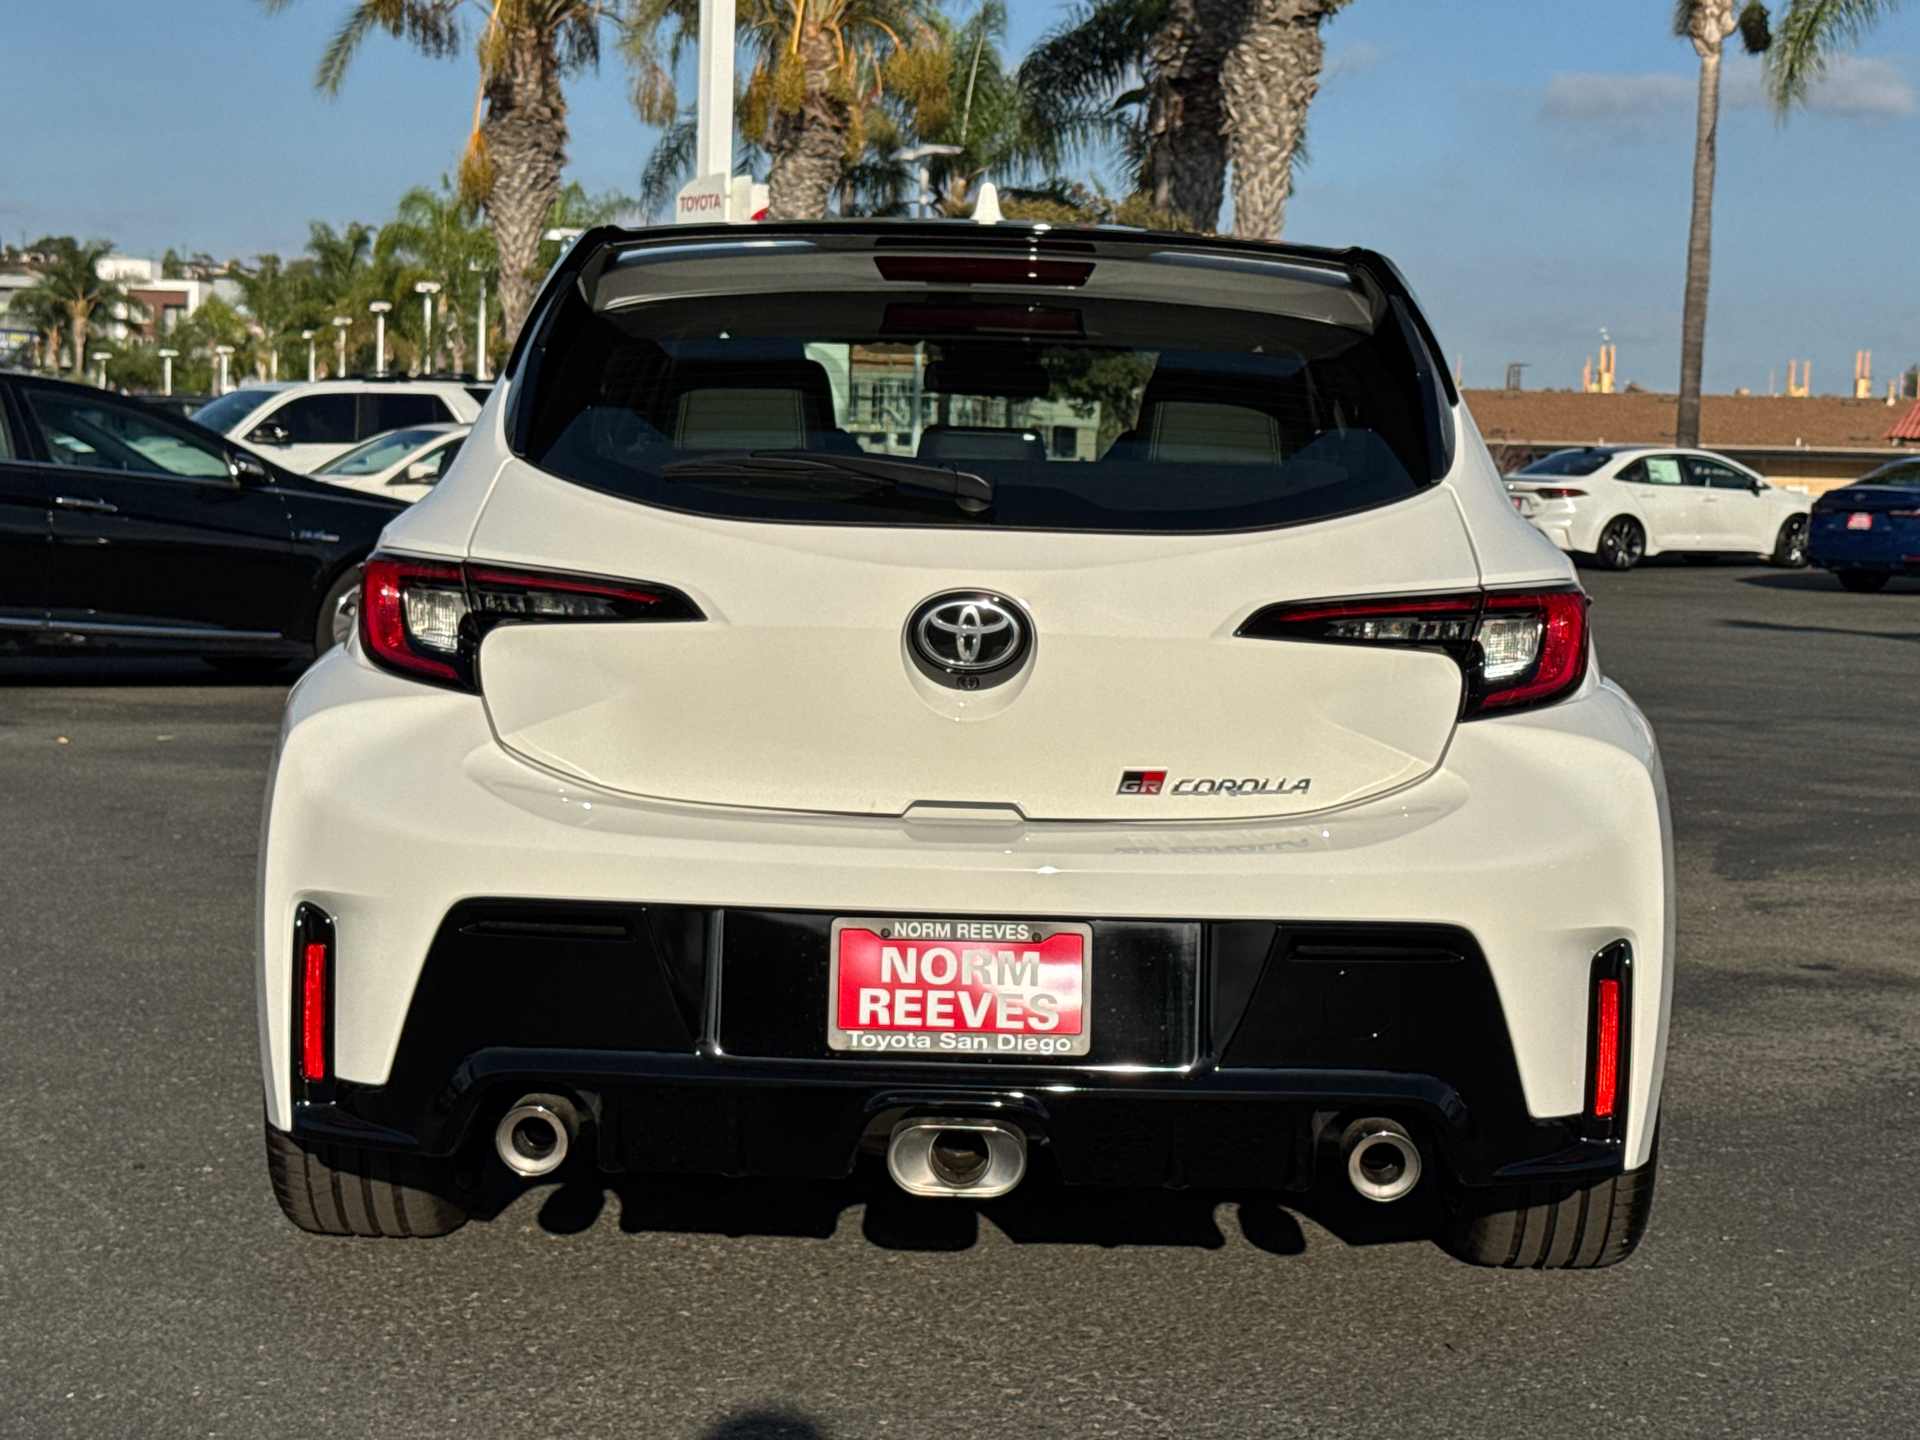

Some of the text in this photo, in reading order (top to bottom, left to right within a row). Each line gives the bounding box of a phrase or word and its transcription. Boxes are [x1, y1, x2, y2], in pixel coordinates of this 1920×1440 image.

[680, 193, 721, 212] TOYOTA
[1119, 778, 1311, 796] GR COROLLA
[894, 922, 1029, 940] NORM REEVES
[881, 946, 1040, 987] NORM
[858, 988, 1060, 1031] REEVES
[846, 1031, 1071, 1055] Toyota San Diego
